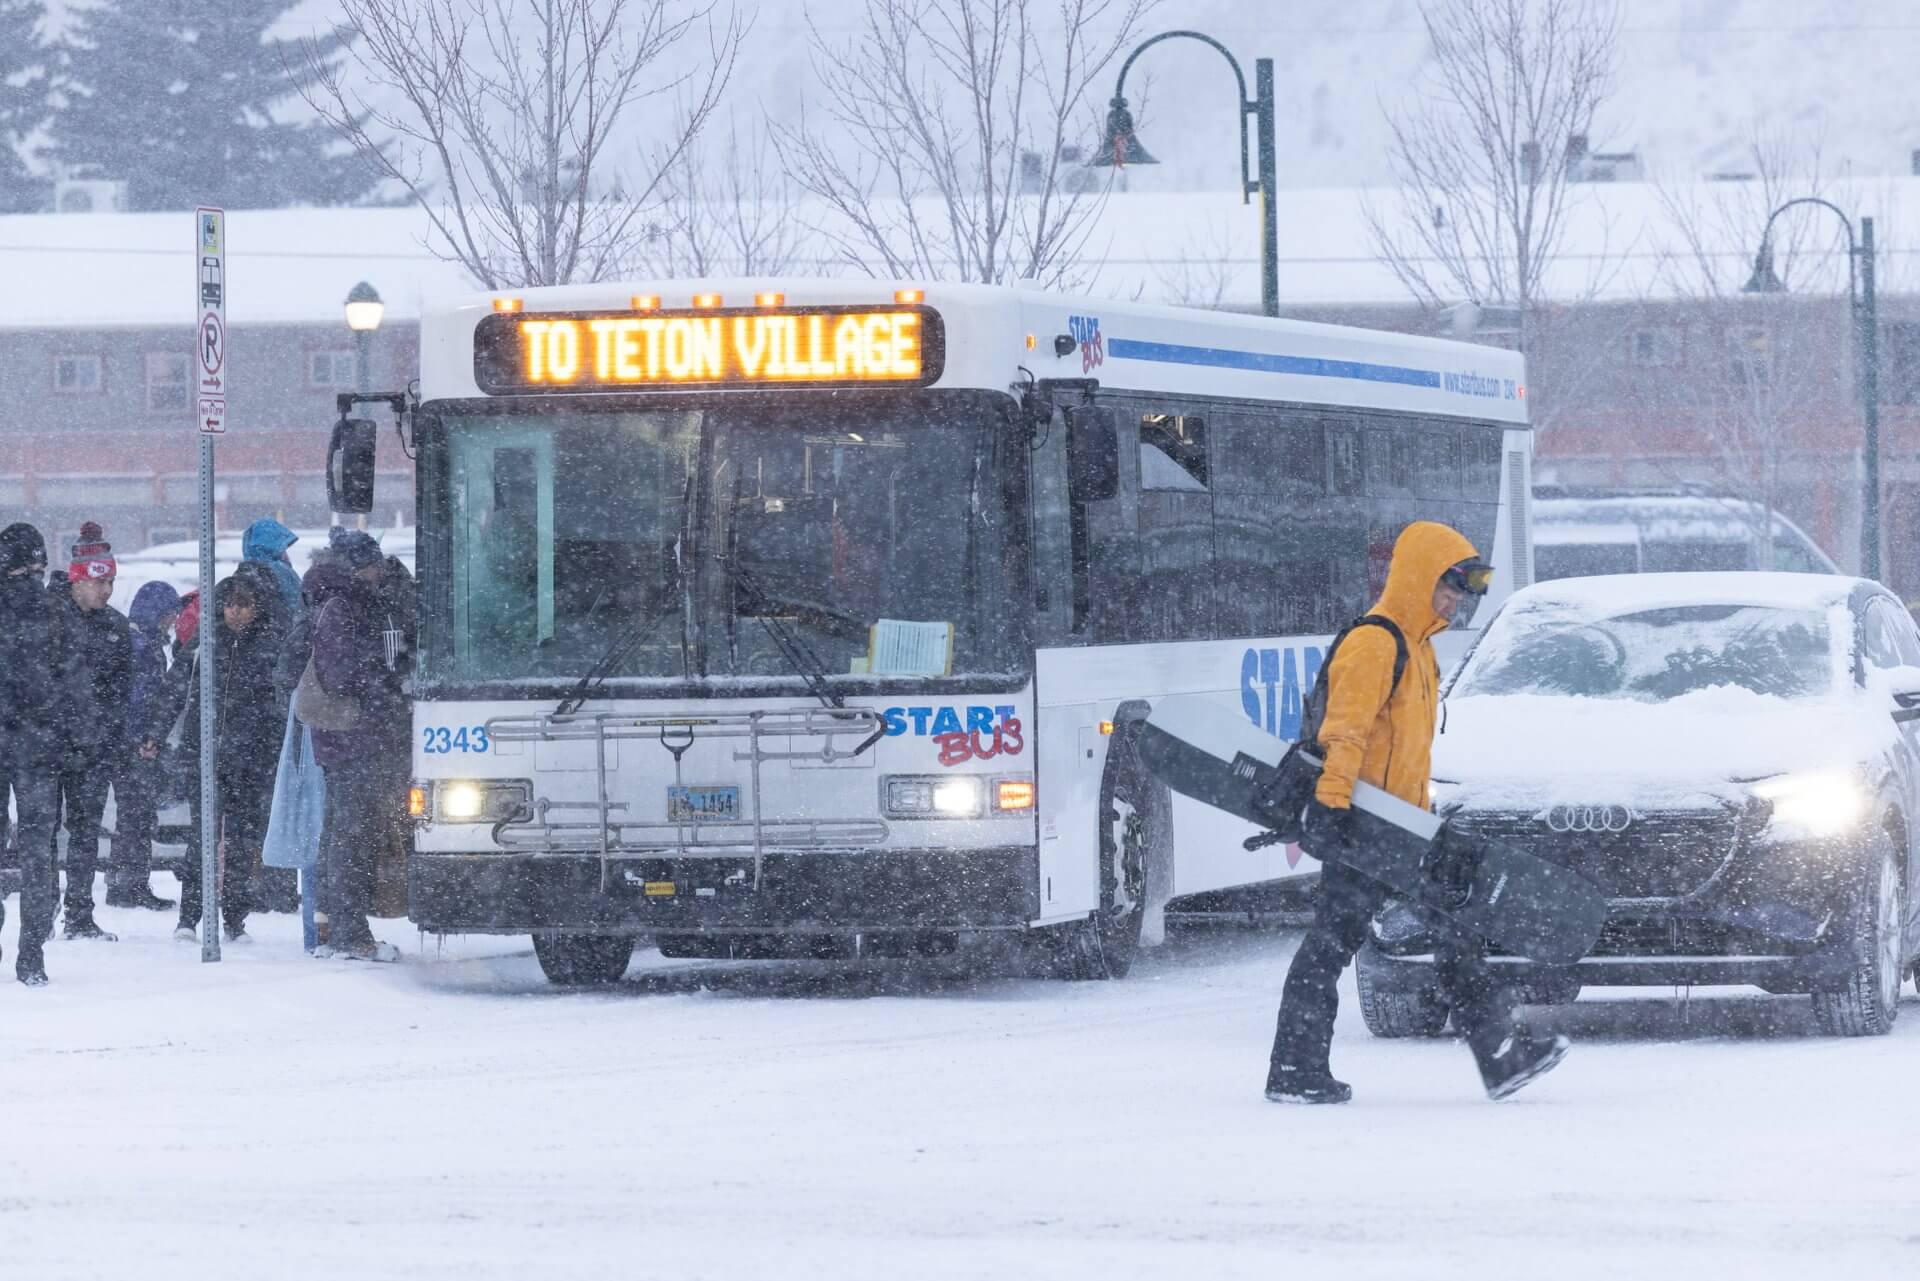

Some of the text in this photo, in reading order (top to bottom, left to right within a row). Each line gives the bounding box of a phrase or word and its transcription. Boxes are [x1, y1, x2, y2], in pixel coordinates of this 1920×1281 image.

[522, 312, 920, 382] TO TETON VILLAGE
[1069, 315, 1099, 344] START
[1081, 330, 1104, 375] BUS
[883, 705, 1015, 736] START
[423, 726, 489, 754] 2343
[932, 718, 1024, 767] BUS
